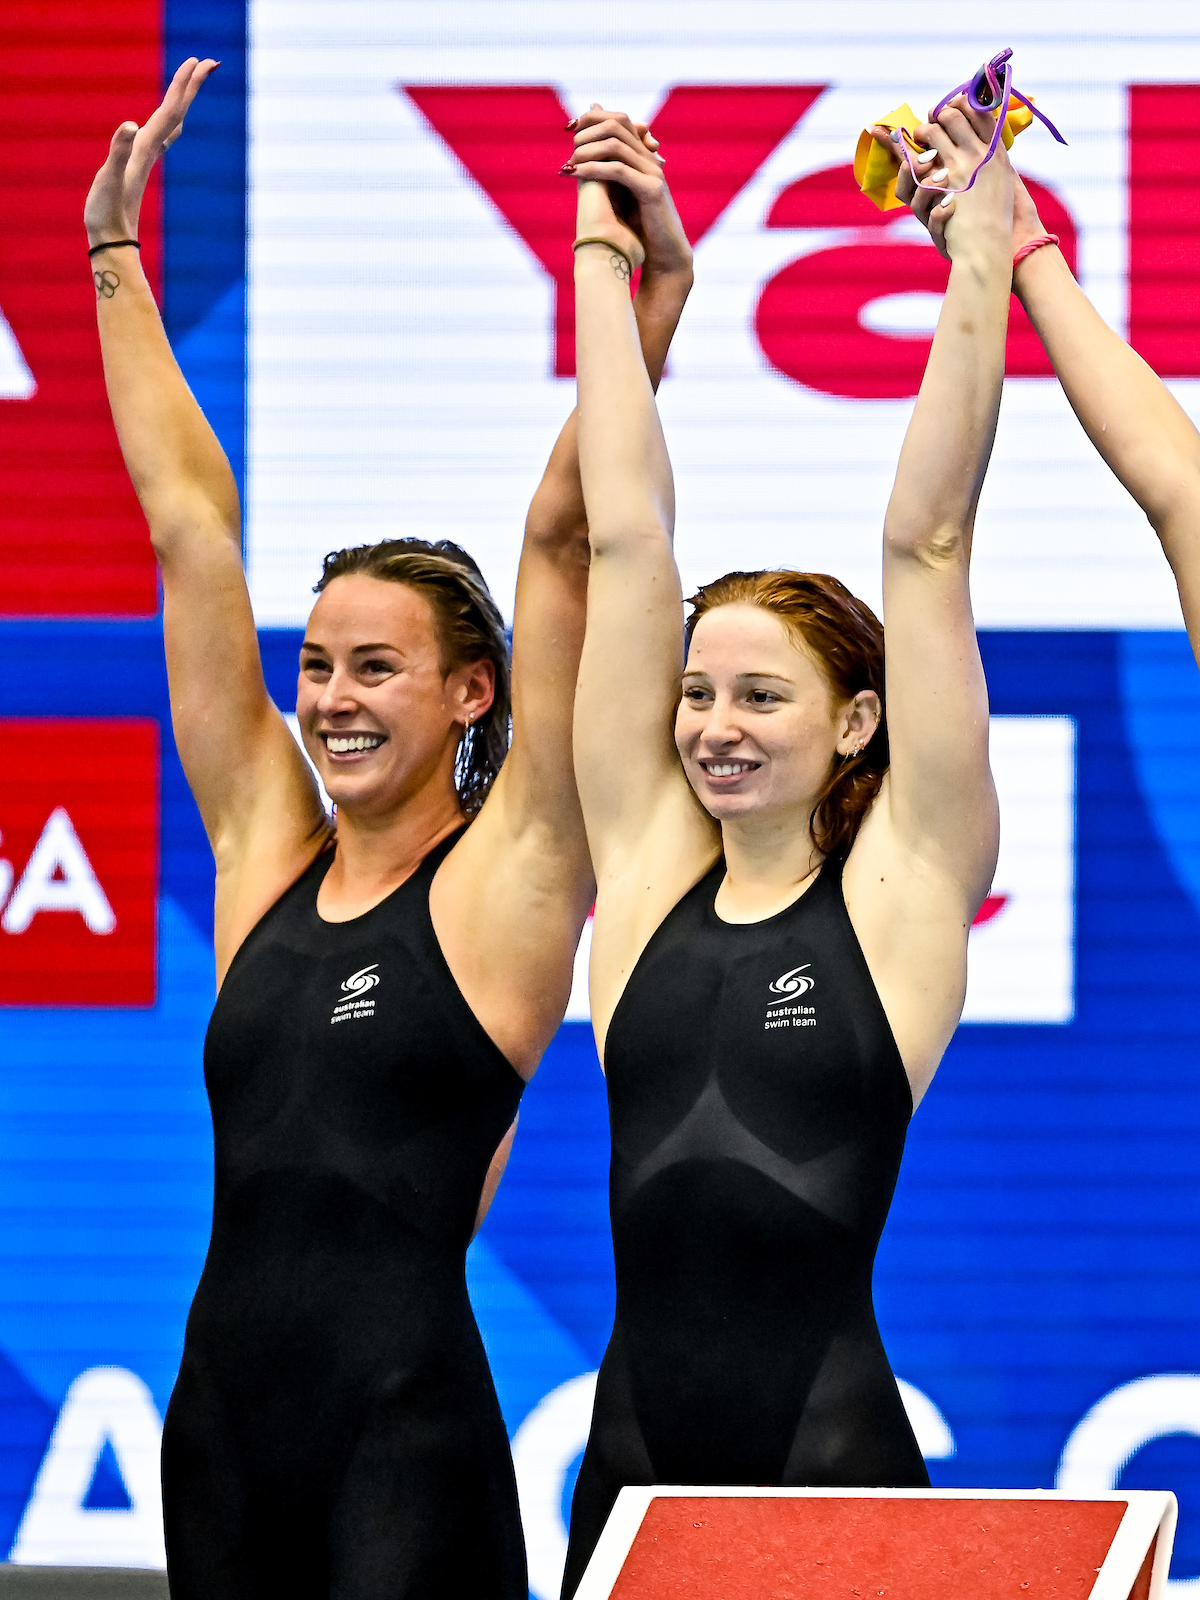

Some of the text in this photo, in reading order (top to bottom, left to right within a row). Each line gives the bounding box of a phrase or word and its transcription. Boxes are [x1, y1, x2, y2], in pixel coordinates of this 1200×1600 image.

[0, 805, 117, 935] A
[333, 999, 376, 1015] australian
[766, 1005, 816, 1019] australian
[330, 1009, 375, 1025] swim team
[764, 1017, 817, 1030] swim team
